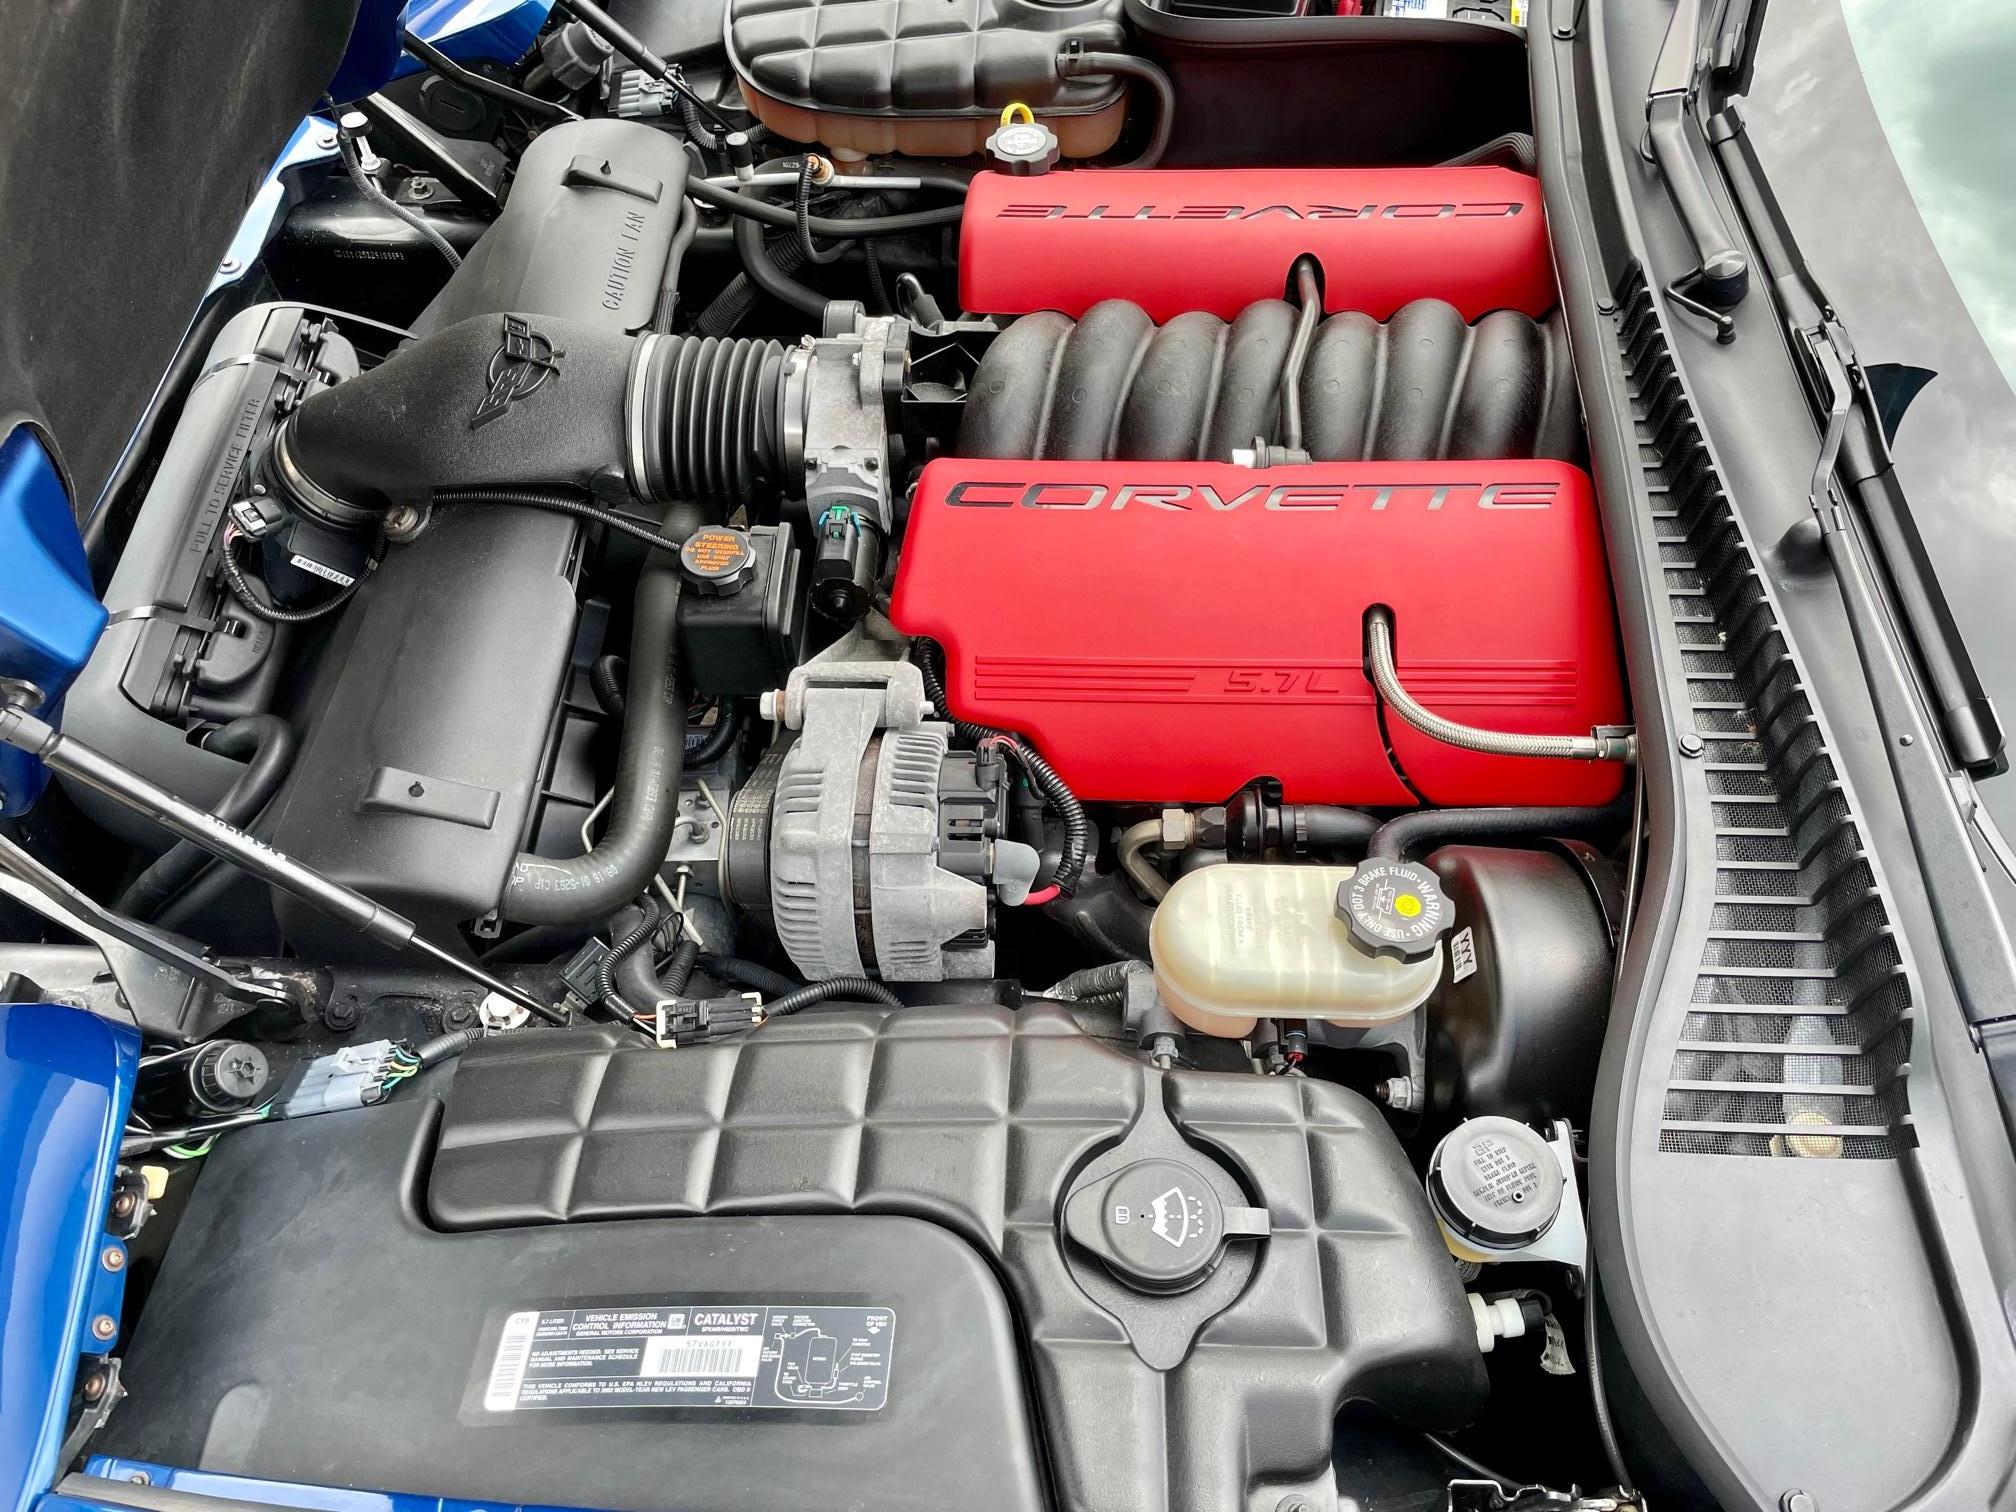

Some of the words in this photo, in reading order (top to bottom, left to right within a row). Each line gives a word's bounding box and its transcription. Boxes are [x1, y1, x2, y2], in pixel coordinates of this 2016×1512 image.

[996, 202, 1524, 219] CORVETTE
[601, 246, 635, 310] CAUTION
[621, 211, 645, 241] FAN
[191, 519, 214, 554] PULL
[205, 498, 220, 515] TO
[214, 444, 243, 495] SERVICE
[236, 398, 261, 439] FILTER
[944, 482, 1560, 511] CORVETTE
[694, 541, 739, 550] STEERING
[703, 534, 736, 542] POWER
[1223, 669, 1340, 694] 5.7L
[1357, 867, 1387, 887] BRAKE
[1389, 866, 1418, 881] FLUID
[1352, 893, 1365, 910] DOT
[1410, 880, 1441, 937] WARNING
[1358, 911, 1383, 933] ONLY
[1383, 929, 1405, 939] USE
[585, 1313, 618, 1322] VEHICLE
[620, 1312, 658, 1321] EMISSION
[694, 1313, 759, 1326] CATALYST
[572, 1322, 610, 1331] CONTROL
[612, 1321, 667, 1330] INFORMATION
